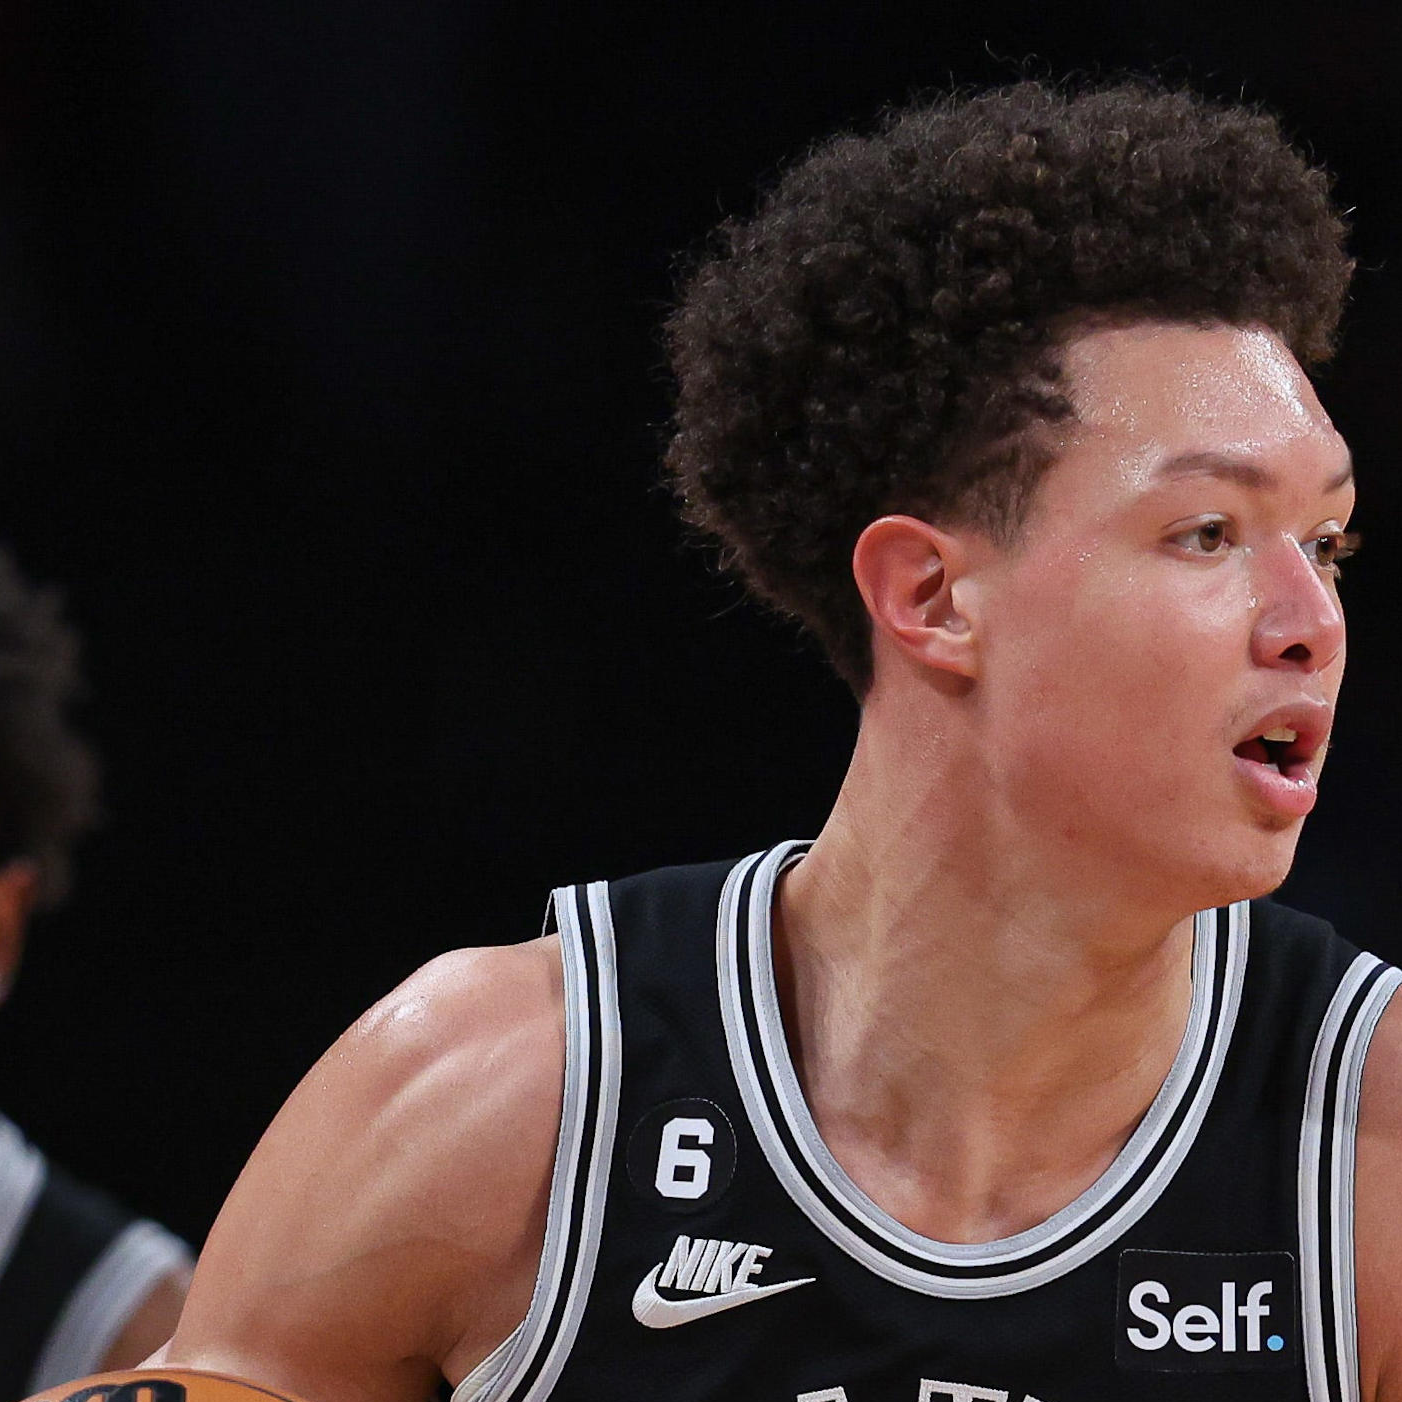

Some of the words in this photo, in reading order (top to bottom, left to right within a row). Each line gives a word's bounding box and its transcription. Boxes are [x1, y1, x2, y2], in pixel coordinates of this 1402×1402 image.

[655, 1117, 715, 1200] 6
[657, 1234, 774, 1294] NIKE
[1125, 1280, 1285, 1355] Self.
